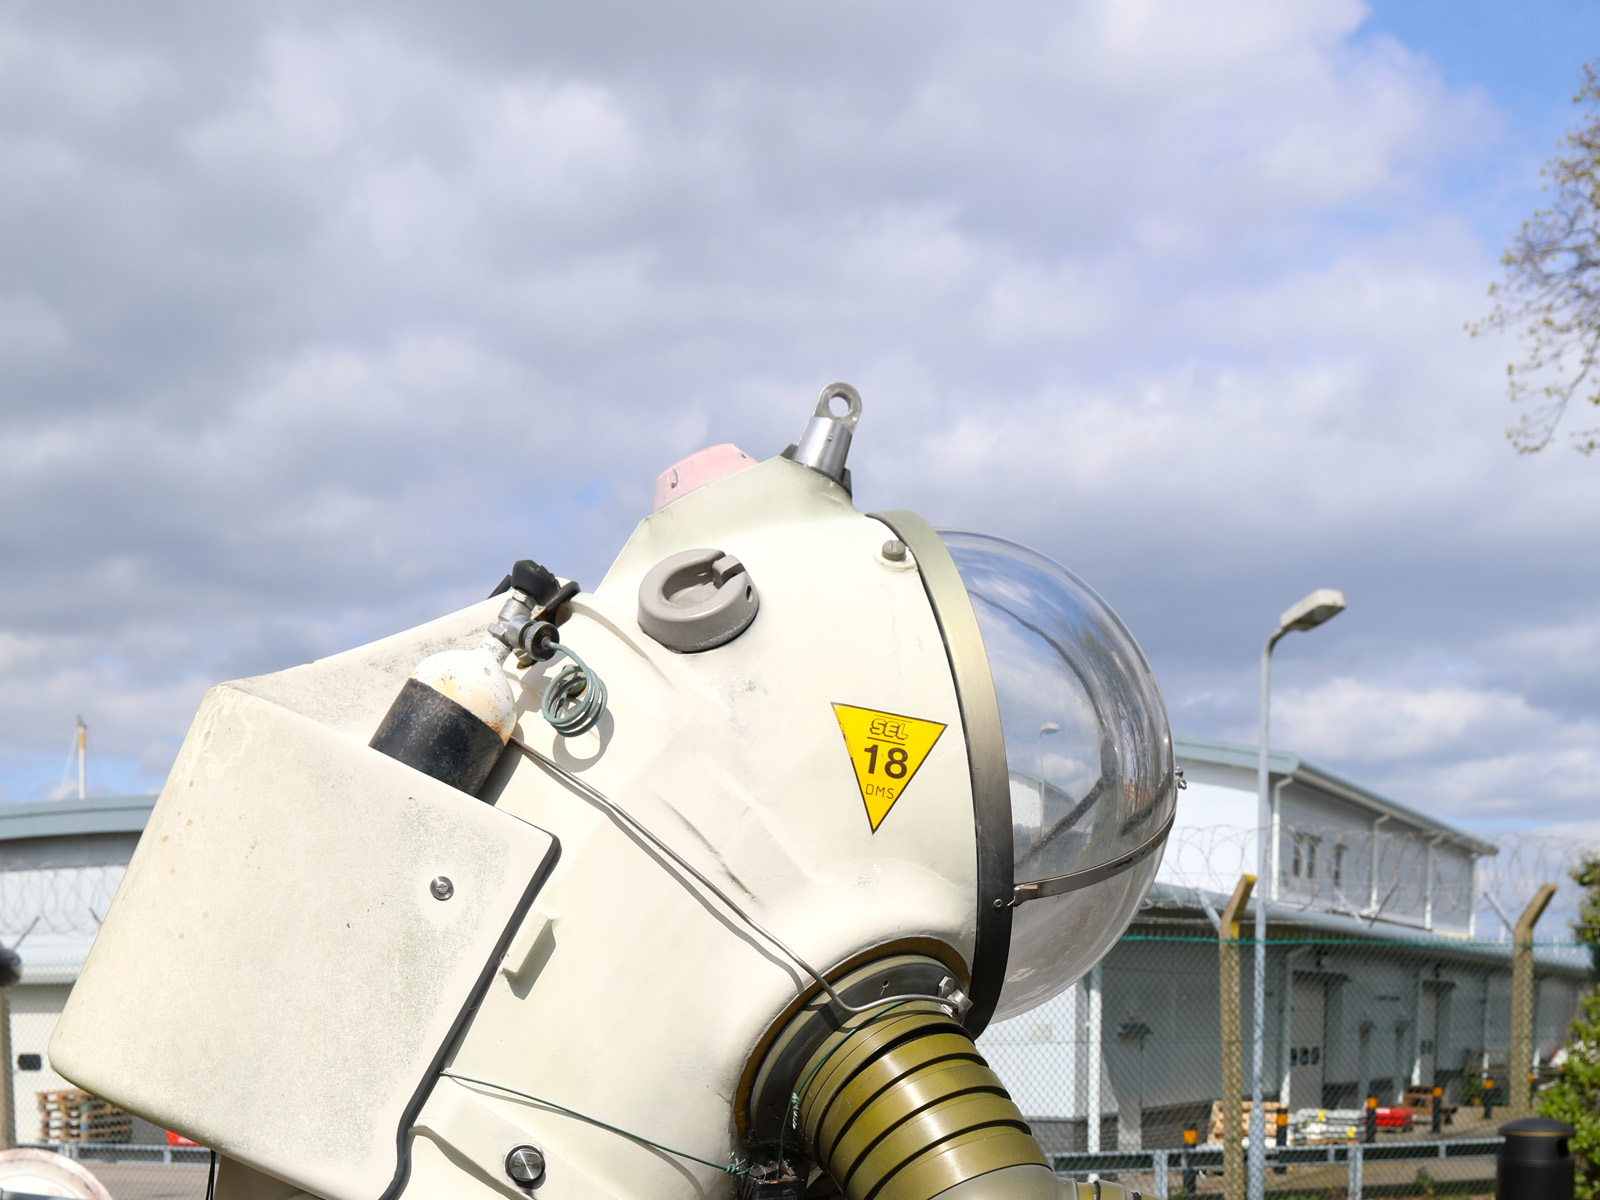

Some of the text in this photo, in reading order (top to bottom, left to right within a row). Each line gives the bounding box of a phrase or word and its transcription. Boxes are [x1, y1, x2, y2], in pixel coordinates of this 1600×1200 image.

[870, 718, 909, 740] SEL
[864, 744, 909, 779] 18
[865, 783, 895, 800] DMS
